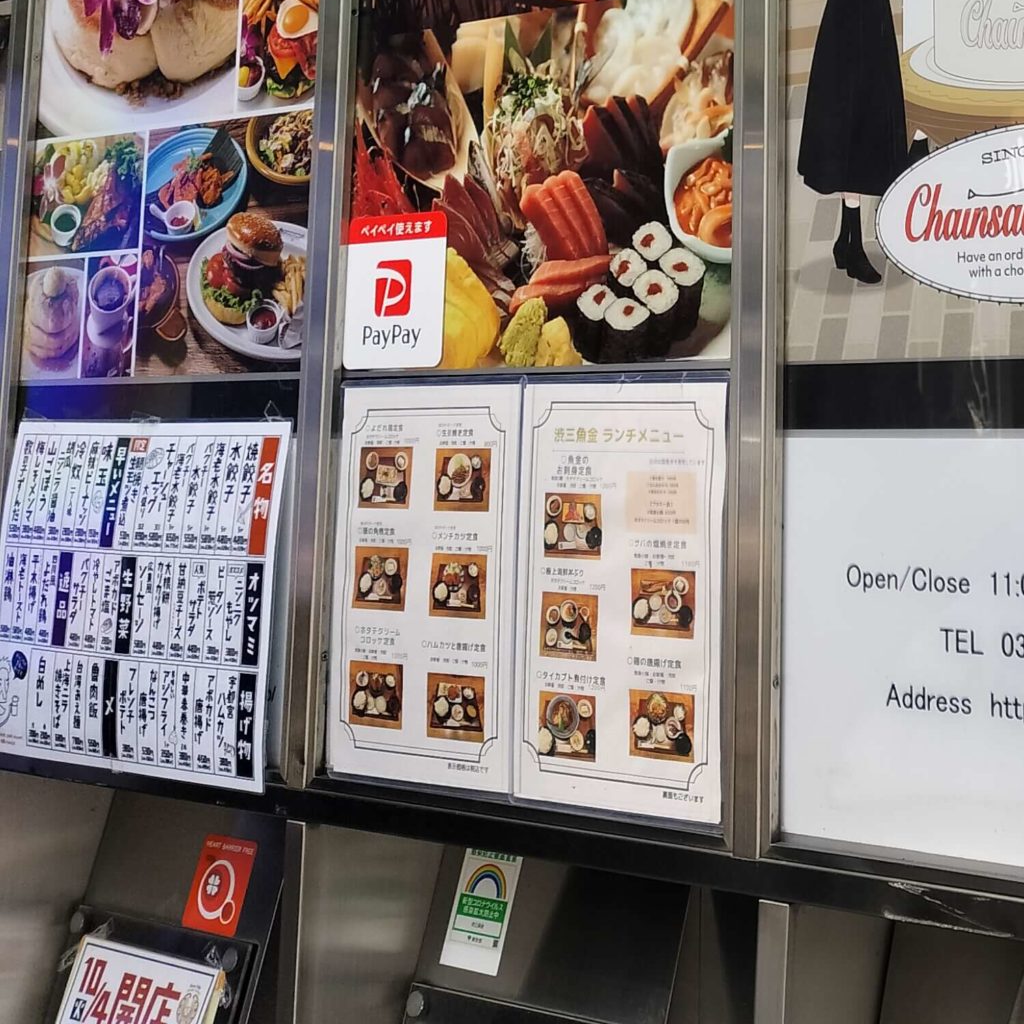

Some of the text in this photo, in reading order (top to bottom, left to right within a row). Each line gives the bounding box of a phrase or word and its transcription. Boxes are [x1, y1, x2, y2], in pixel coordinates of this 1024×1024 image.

[361, 220, 432, 237] ペイペイ使えます
[957, 250, 985, 264] Have
[986, 251, 1003, 262] an
[968, 264, 993, 278] with
[994, 267, 1002, 277] a
[362, 324, 421, 350] PayPay
[603, 428, 684, 443] ランチメニュー
[223, 443, 242, 504] 水餃子
[105, 447, 127, 536] 早いメニュー
[253, 463, 275, 519] 名物
[846, 564, 971, 595] Open/Close
[118, 569, 133, 639] 生野菜
[247, 573, 260, 656] オツマミ
[939, 627, 984, 656] TEL
[886, 683, 973, 715] Address
[238, 691, 253, 761] 揚げ物
